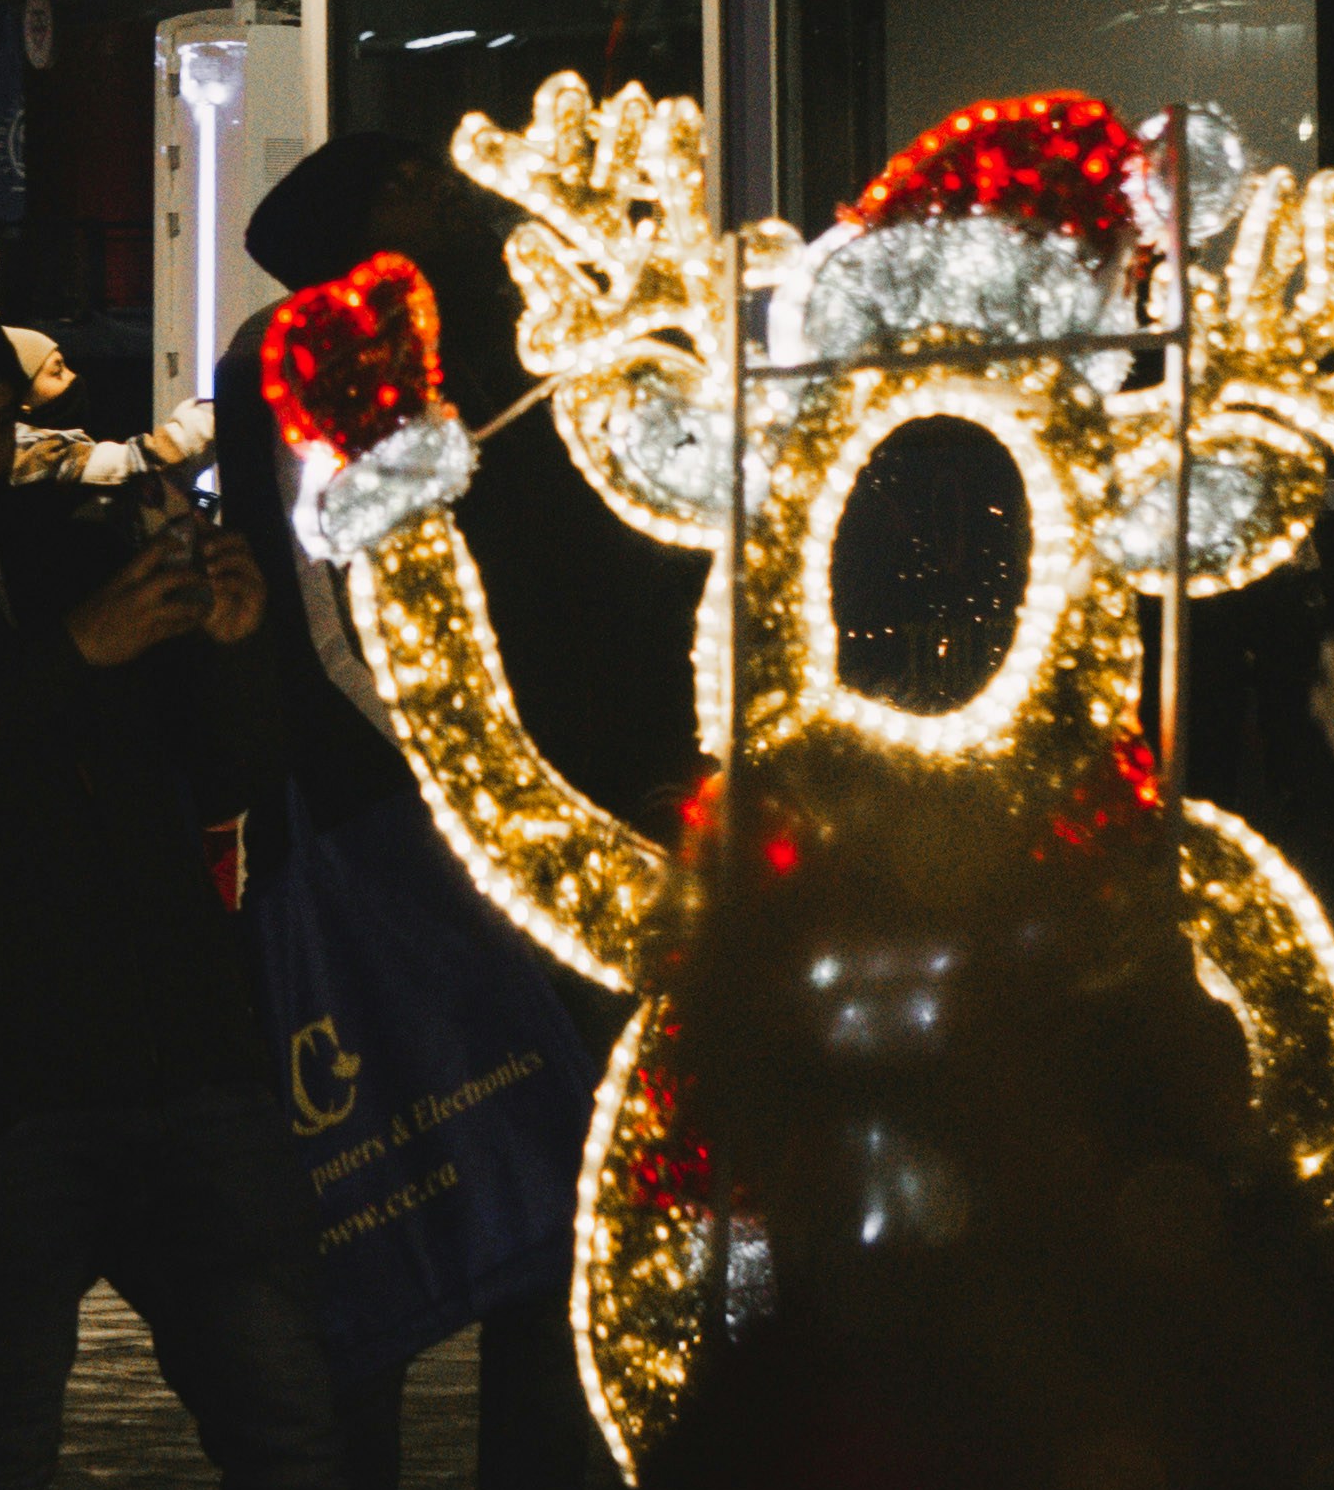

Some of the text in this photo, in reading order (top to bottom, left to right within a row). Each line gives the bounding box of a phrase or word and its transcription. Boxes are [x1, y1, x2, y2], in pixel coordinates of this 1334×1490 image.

[310, 1047, 545, 1198] puters & Electronics
